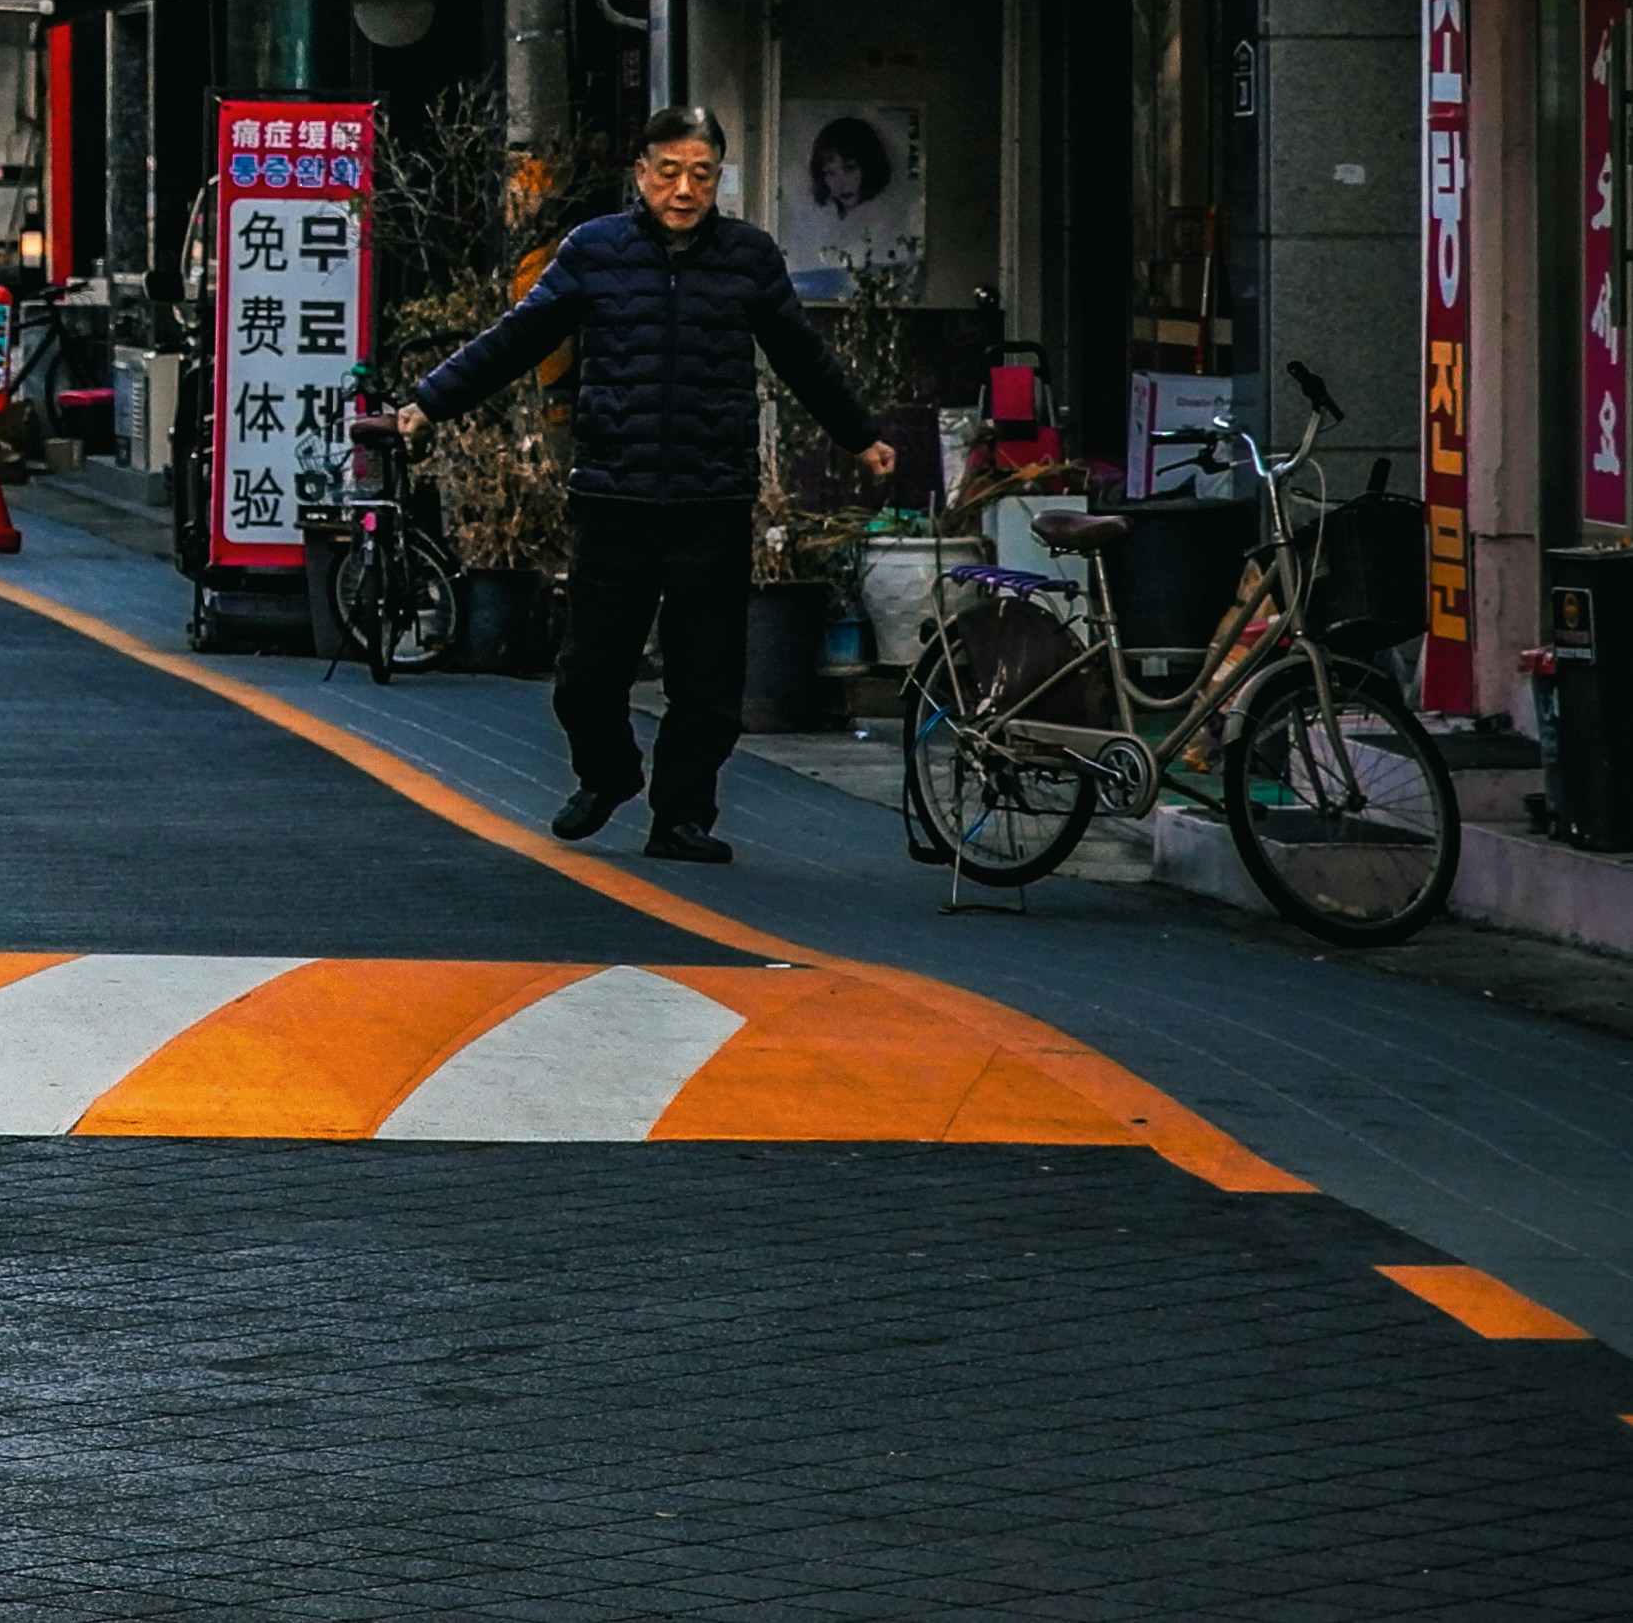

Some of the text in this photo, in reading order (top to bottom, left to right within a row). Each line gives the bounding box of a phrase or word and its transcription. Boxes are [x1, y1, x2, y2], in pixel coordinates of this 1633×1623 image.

[229, 154, 361, 188] 통증완화
[230, 210, 287, 530] 免费体验
[1430, 340, 1468, 642] 전문
